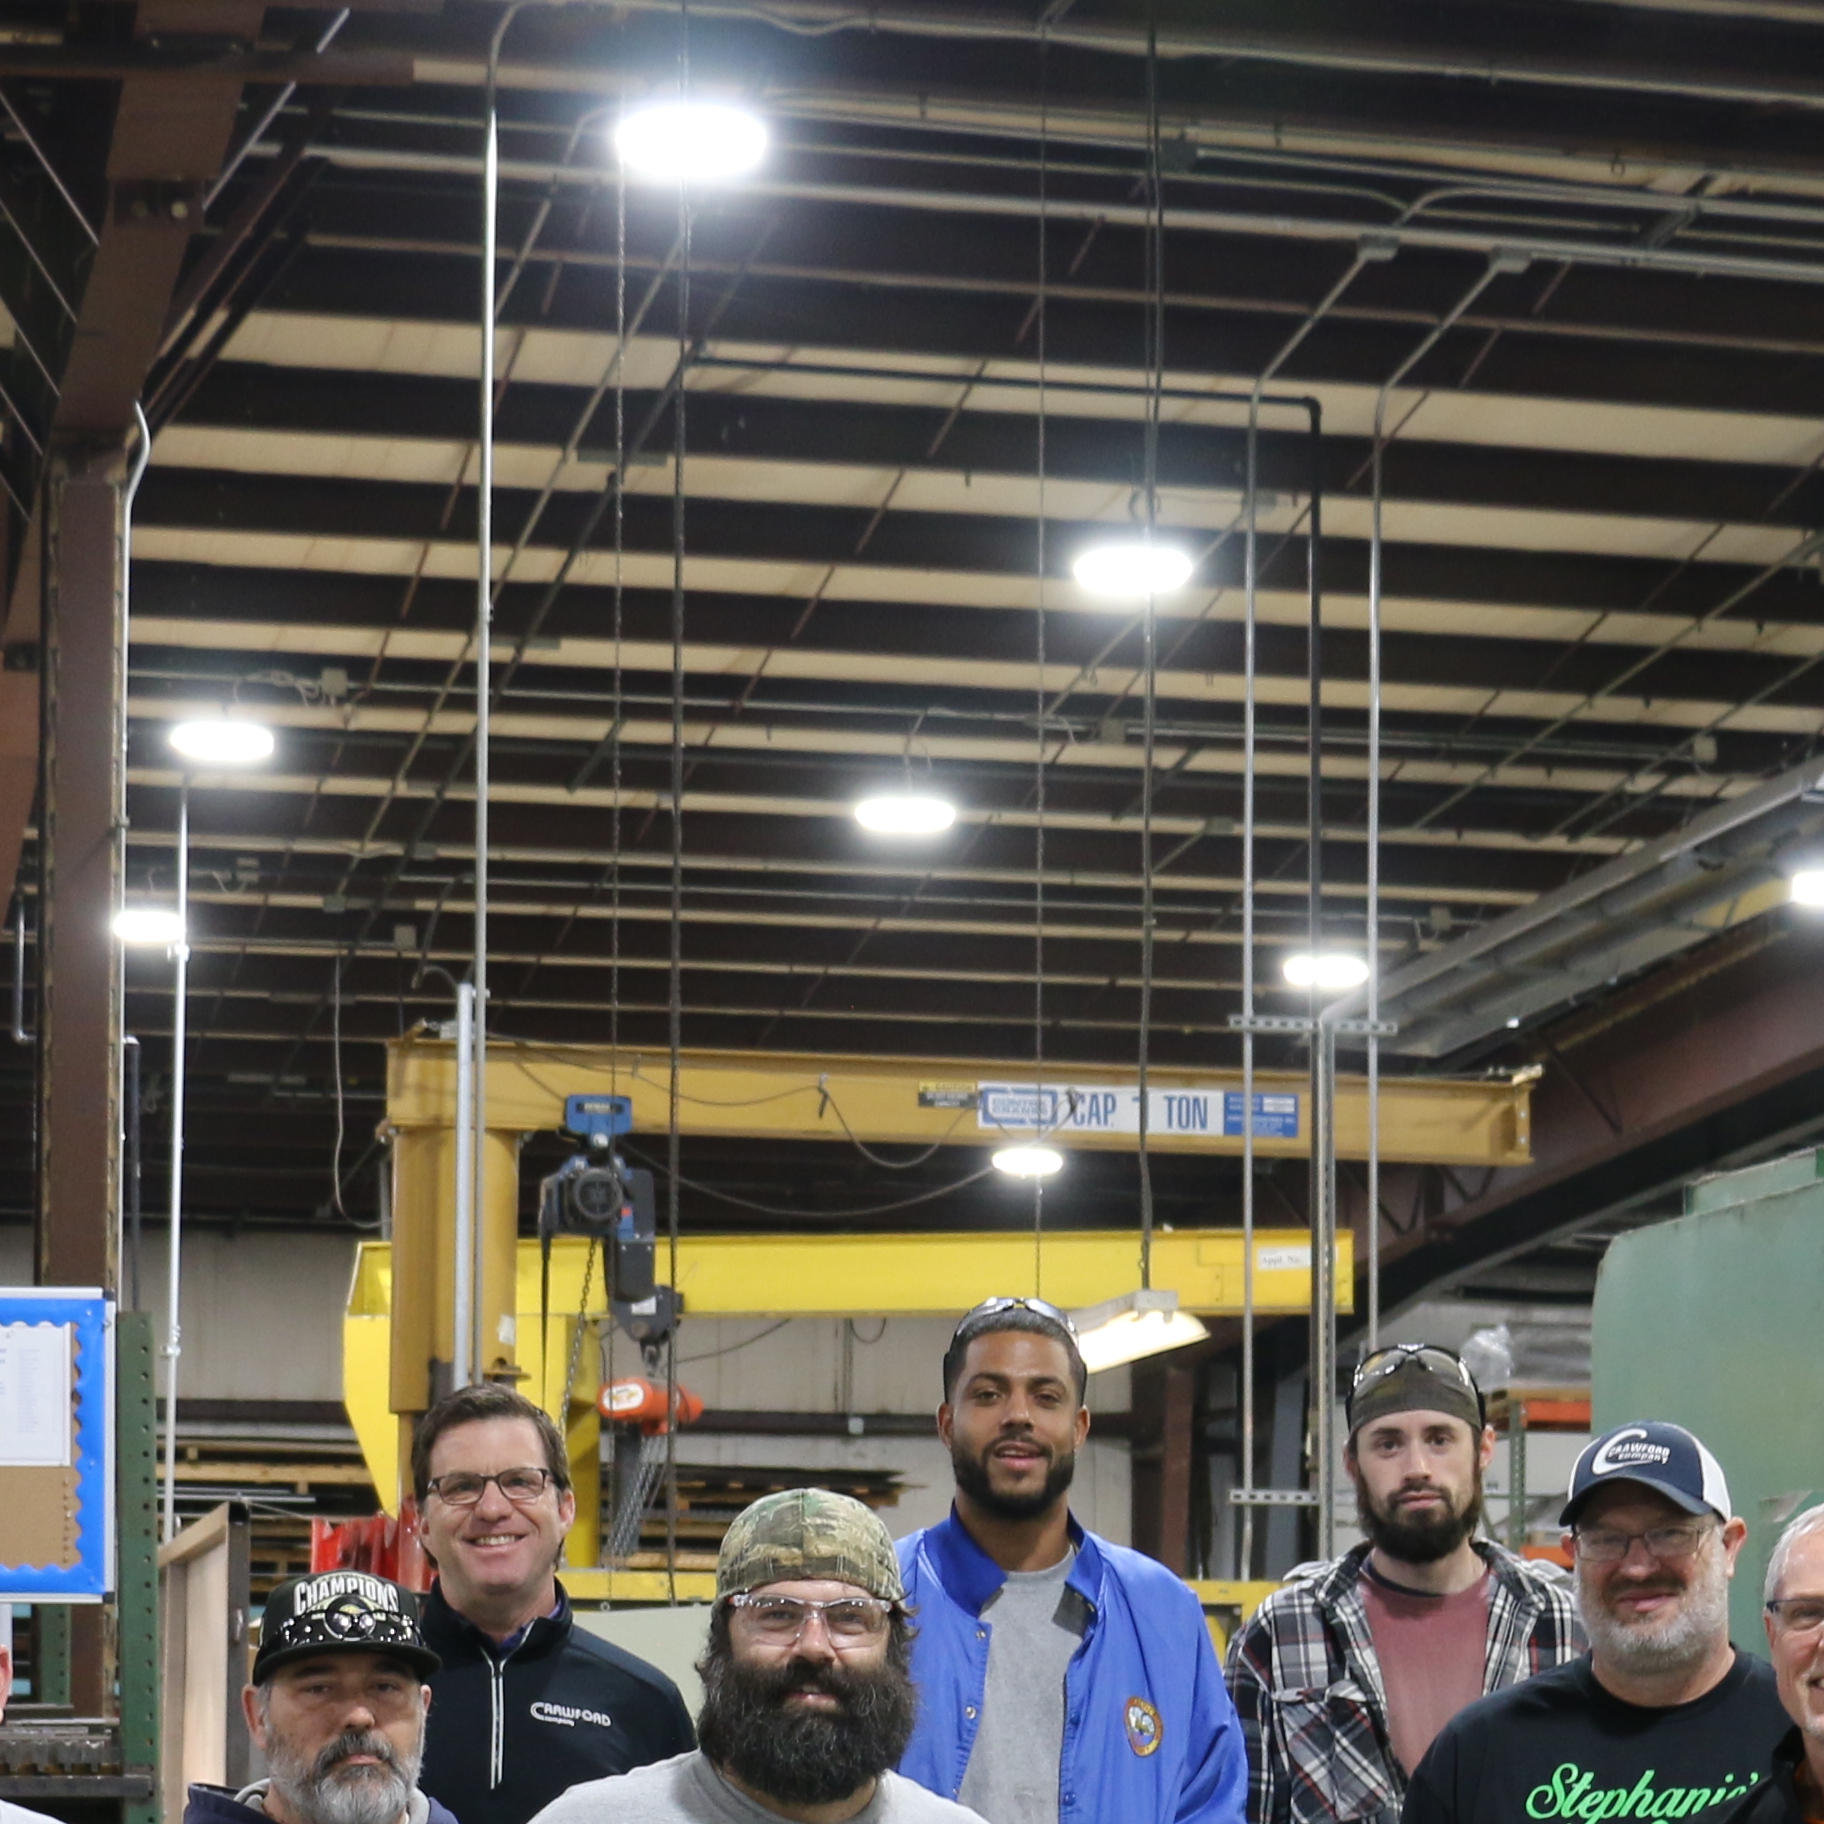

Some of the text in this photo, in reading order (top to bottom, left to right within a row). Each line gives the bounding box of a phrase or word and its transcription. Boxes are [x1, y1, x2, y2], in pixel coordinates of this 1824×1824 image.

[1164, 1095, 1208, 1130] TON
[293, 1576, 400, 1616] CHAMPIONS
[530, 1701, 612, 1727] CRAWFORD
